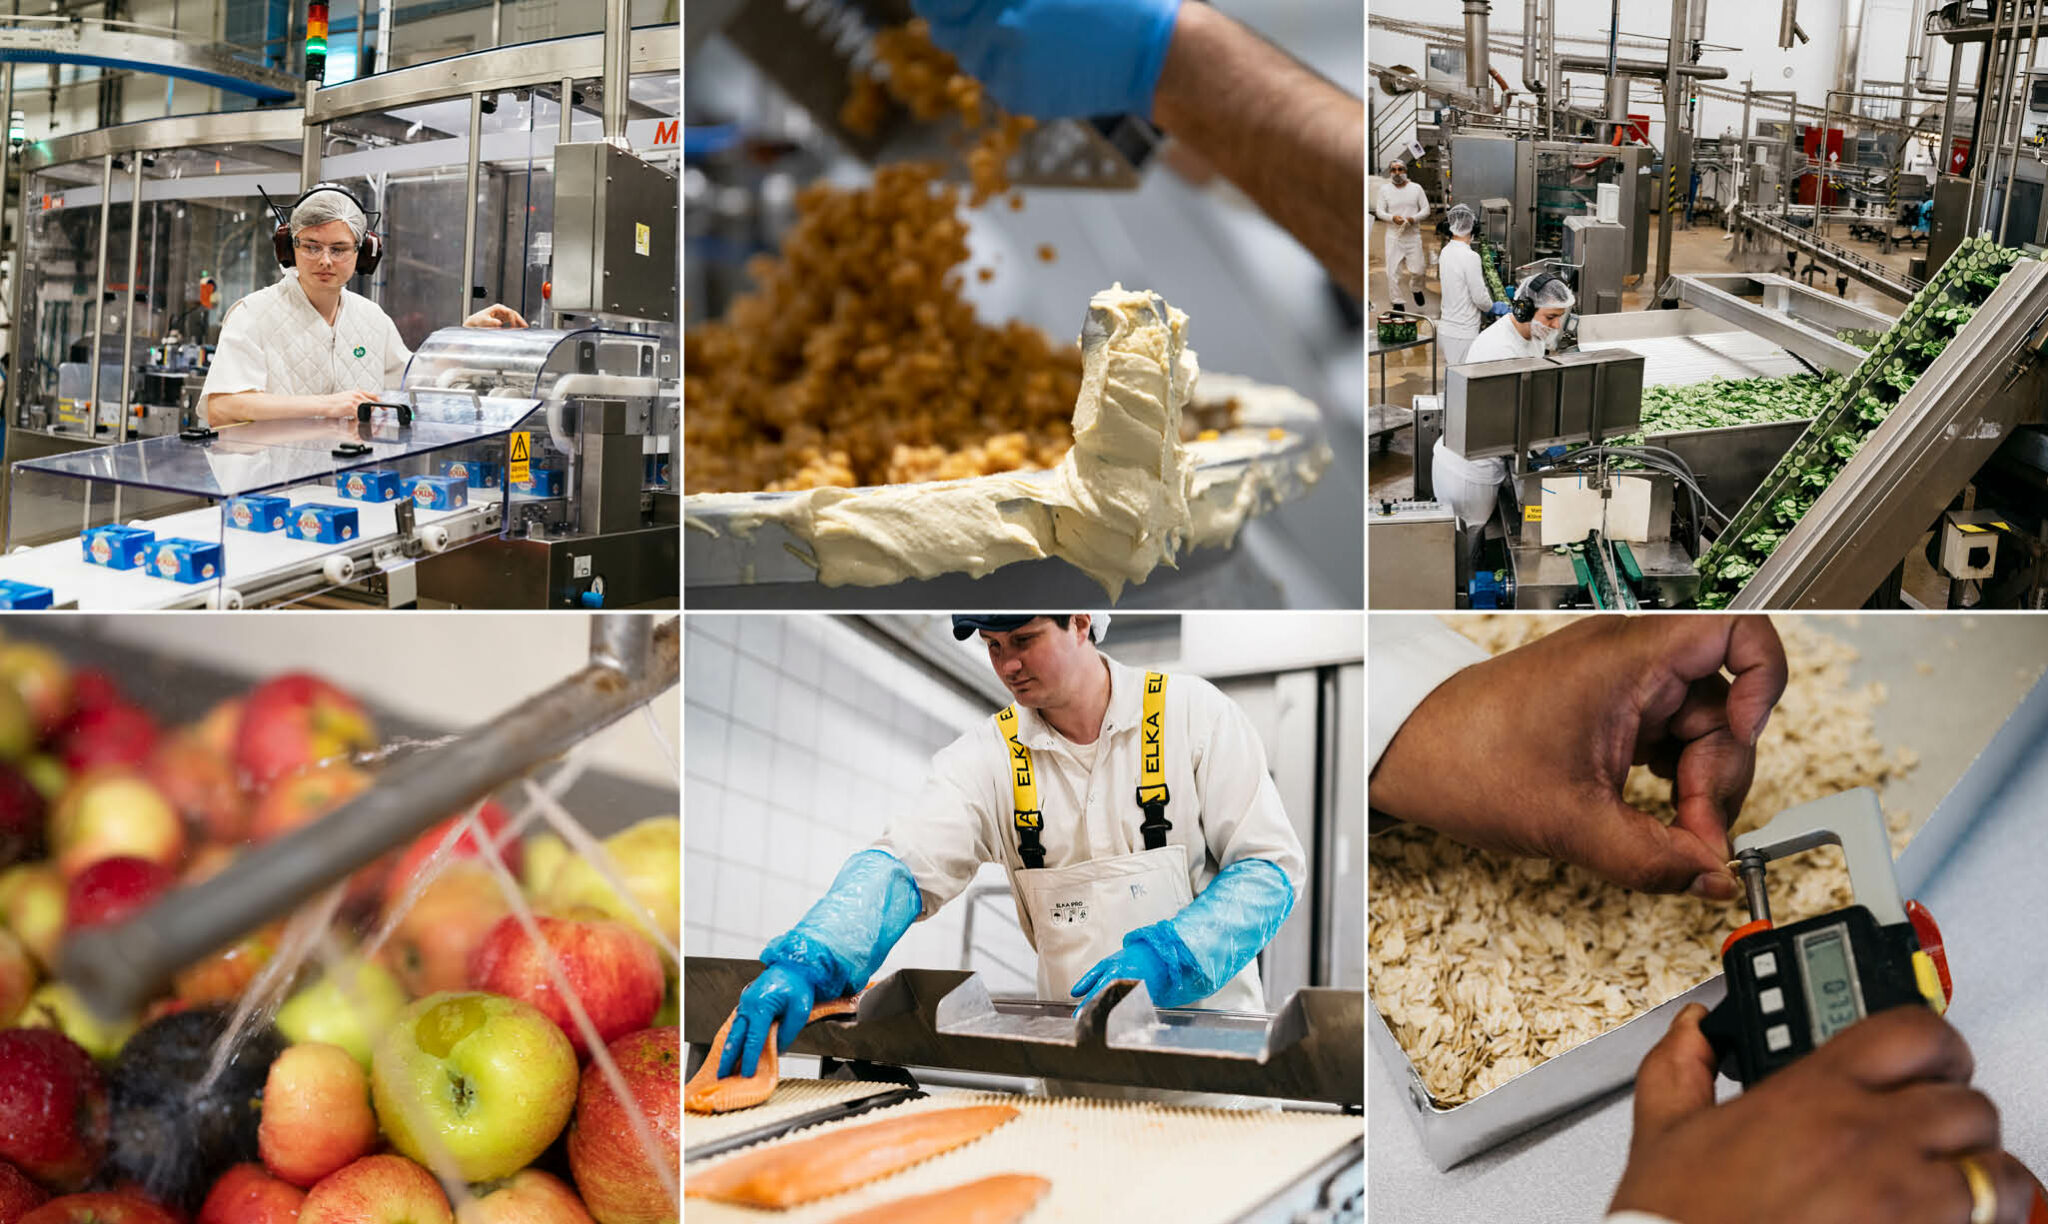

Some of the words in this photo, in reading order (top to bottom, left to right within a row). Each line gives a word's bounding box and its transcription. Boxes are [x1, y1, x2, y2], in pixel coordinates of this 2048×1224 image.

[653, 120, 680, 145] M
[1148, 671, 1163, 694] EL
[1008, 733, 1032, 787] ELKA
[1145, 711, 1160, 774] ELKA
